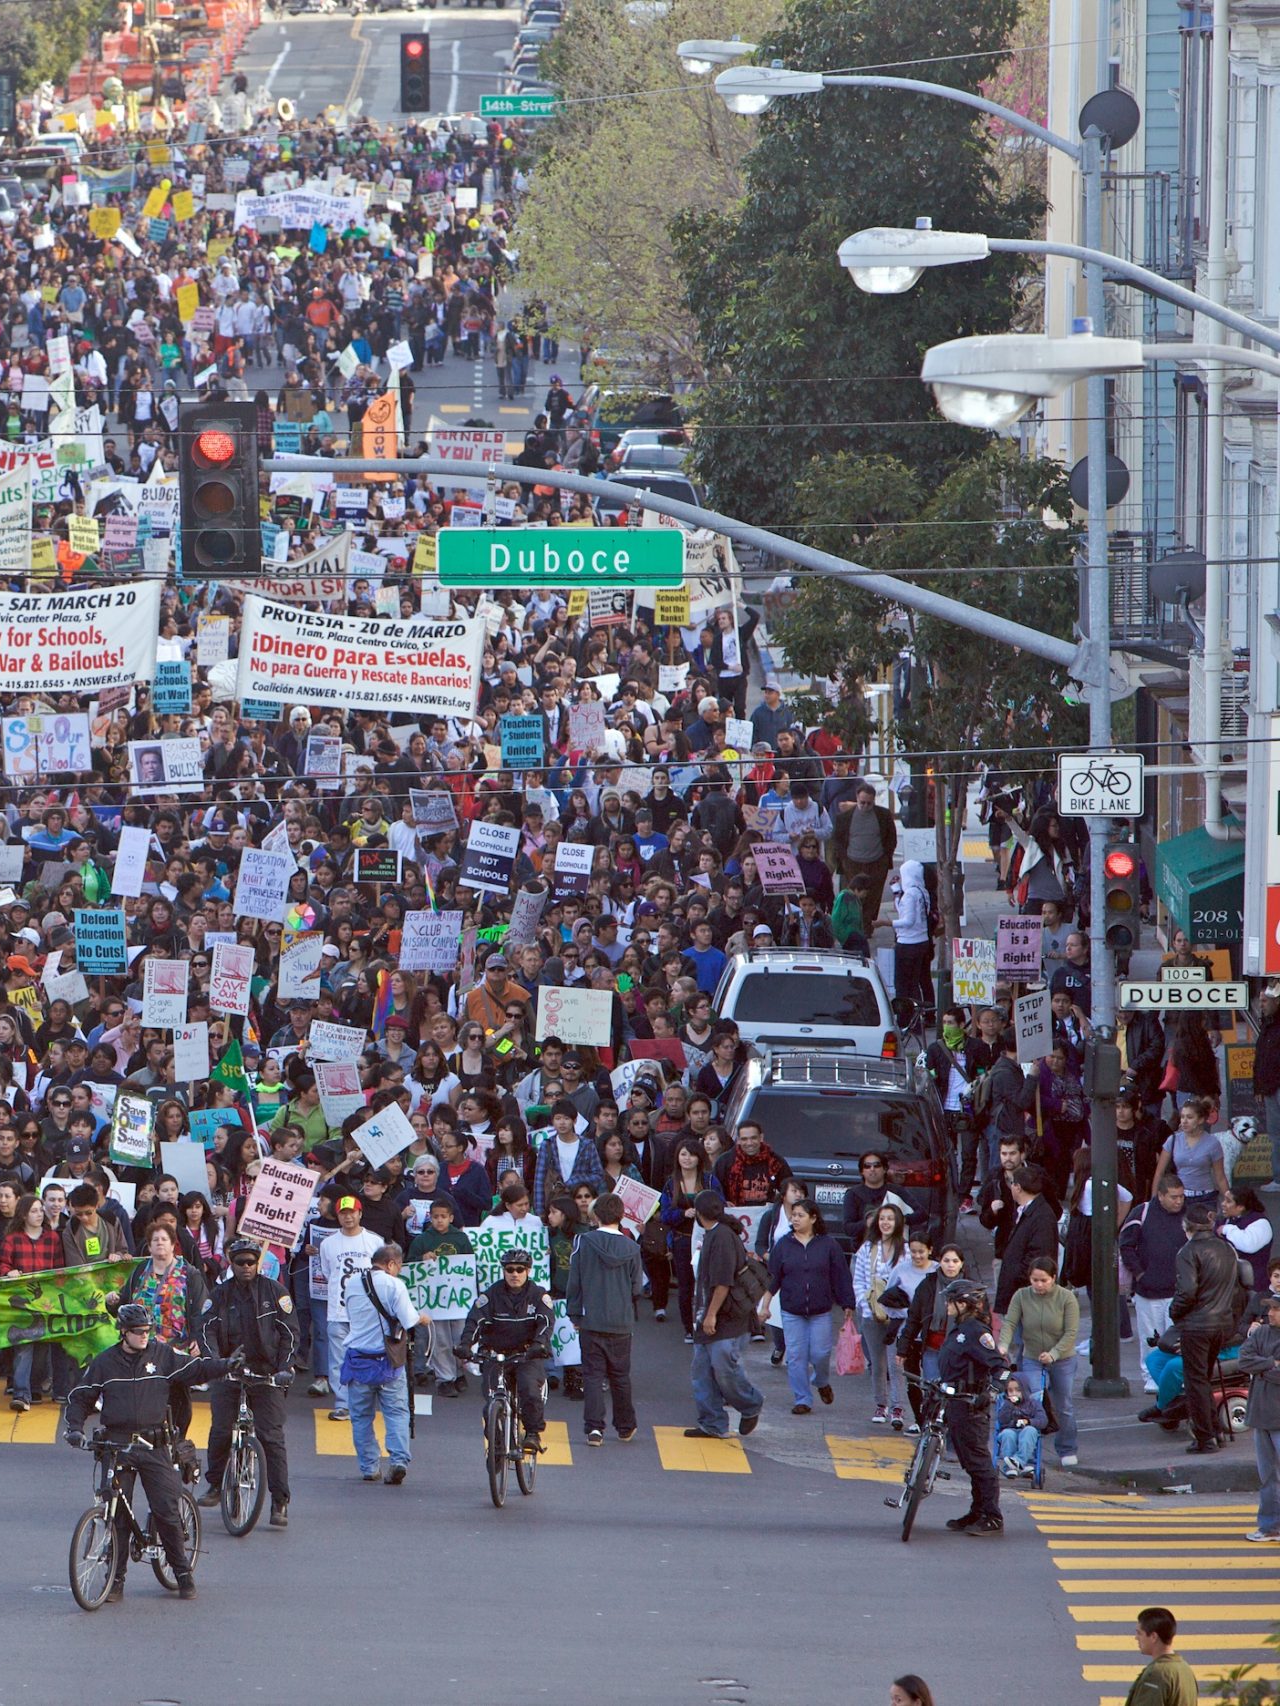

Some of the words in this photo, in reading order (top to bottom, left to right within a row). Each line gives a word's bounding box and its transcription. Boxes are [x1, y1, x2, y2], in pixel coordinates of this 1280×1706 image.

[485, 101, 514, 112] 14th
[435, 430, 503, 443] ARNOLD
[437, 445, 503, 461] YOU'RE
[490, 543, 631, 573] Duboce
[9, 597, 40, 610] SAT.
[47, 593, 111, 608] MARCH
[116, 591, 136, 605] 20
[17, 614, 50, 623] Center
[52, 612, 82, 623] Plaza,
[85, 612, 97, 621] SF
[261, 605, 344, 630] PROTESTA
[360, 622, 380, 636] 20
[383, 624, 404, 637] de
[407, 623, 465, 638] MARZO
[7, 626, 32, 647] for
[37, 625, 107, 647] Schools,
[327, 632, 352, 643] Plaza
[356, 636, 387, 647] Centro
[31, 654, 43, 672] &
[49, 646, 124, 672] Bailouts!
[333, 644, 379, 667] para
[250, 657, 268, 672] No
[271, 662, 300, 680] para
[303, 662, 348, 681] Guerra
[350, 670, 358, 683] y
[361, 667, 408, 684] Rescate
[410, 671, 472, 690] Bancarios!
[252, 682, 294, 694] Coalición
[297, 686, 336, 698] ANSWER
[502, 719, 541, 729] Teachers
[506, 745, 538, 756] United
[1070, 798, 1094, 810] BIKE
[1101, 798, 1131, 810] LANE
[479, 827, 511, 840] CLOSE
[471, 840, 513, 853] LOOPHOLES
[479, 856, 498, 866] NOT
[467, 866, 508, 881] SCHOOLS
[1193, 910, 1228, 923] 208
[999, 920, 1041, 929] Education
[1011, 934, 1019, 945] is
[1023, 936, 1028, 945] a
[1003, 952, 1035, 965] Right!
[1166, 969, 1188, 979] 100
[1129, 987, 1238, 1003] DUBOCE
[1019, 997, 1043, 1011] STOP
[1023, 1025, 1043, 1037] CUTS
[261, 1164, 314, 1189] Education
[270, 1181, 283, 1195] is
[286, 1189, 293, 1200] a
[256, 1201, 296, 1223] Right!
